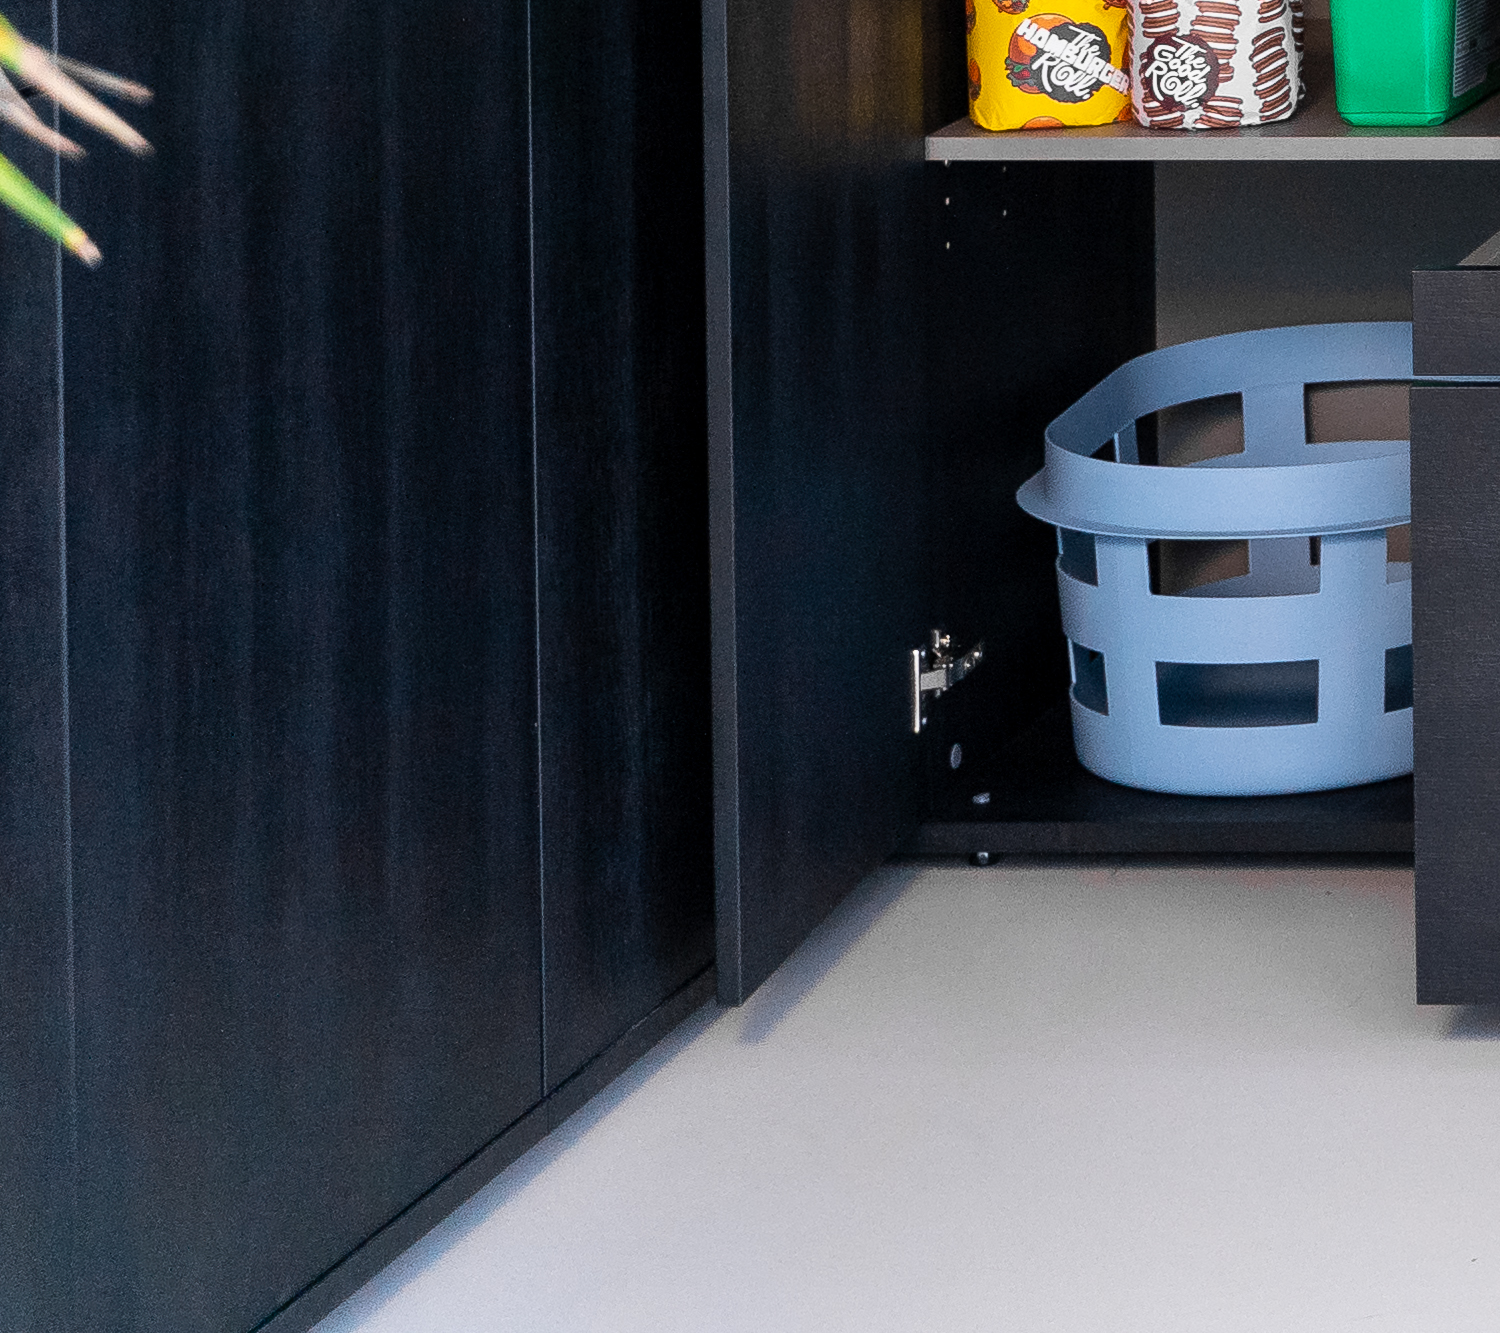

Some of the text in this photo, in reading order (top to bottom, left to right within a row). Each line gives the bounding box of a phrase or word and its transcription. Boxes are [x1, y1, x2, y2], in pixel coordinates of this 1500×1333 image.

[1016, 18, 1130, 95] HAMBURGER
[1068, 25, 1102, 56] The
[1171, 36, 1207, 69] The
[1152, 44, 1211, 84] Good
[1144, 61, 1208, 109] Roll.
